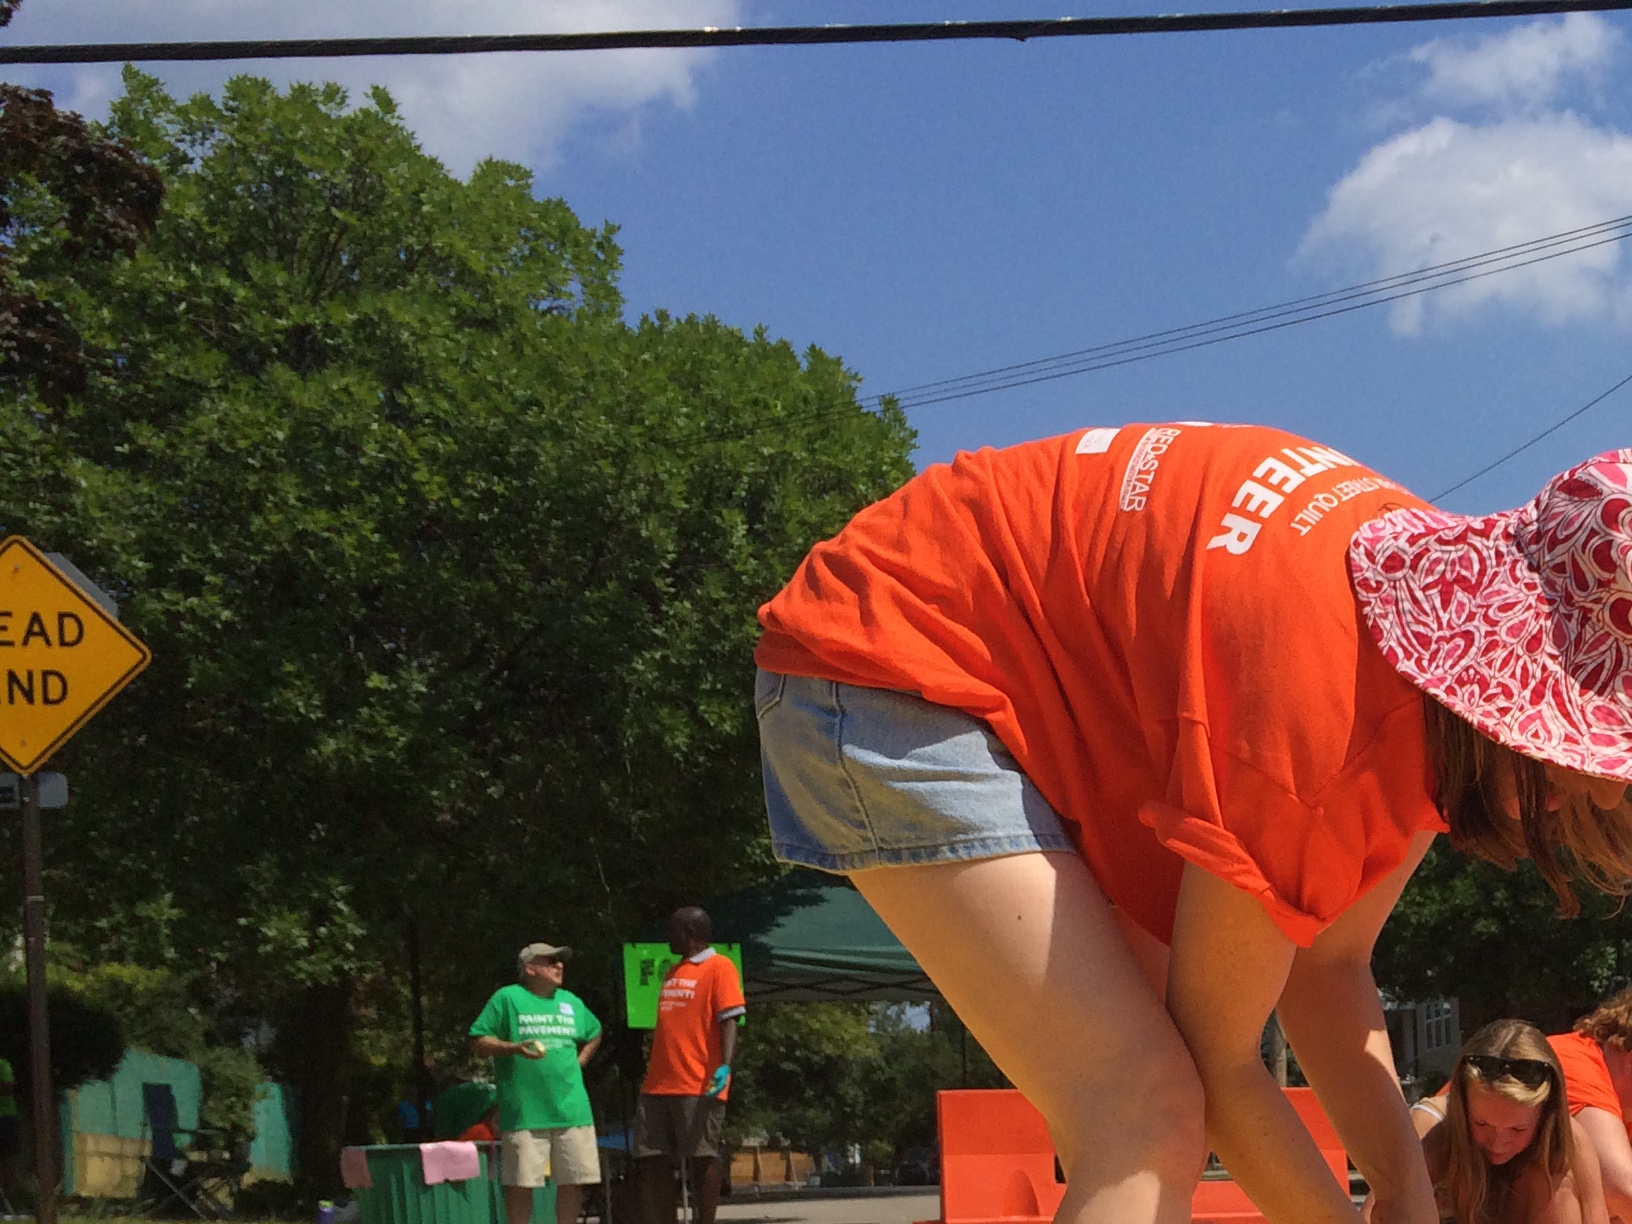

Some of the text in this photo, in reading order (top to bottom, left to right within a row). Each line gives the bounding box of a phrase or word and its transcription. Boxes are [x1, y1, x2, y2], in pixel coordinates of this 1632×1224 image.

[1124, 459, 1159, 513] STAR
[1206, 445, 1363, 556] NTEER
[1290, 493, 1339, 536] QUILT
[0, 611, 84, 647] EAD
[7, 669, 68, 706] ND
